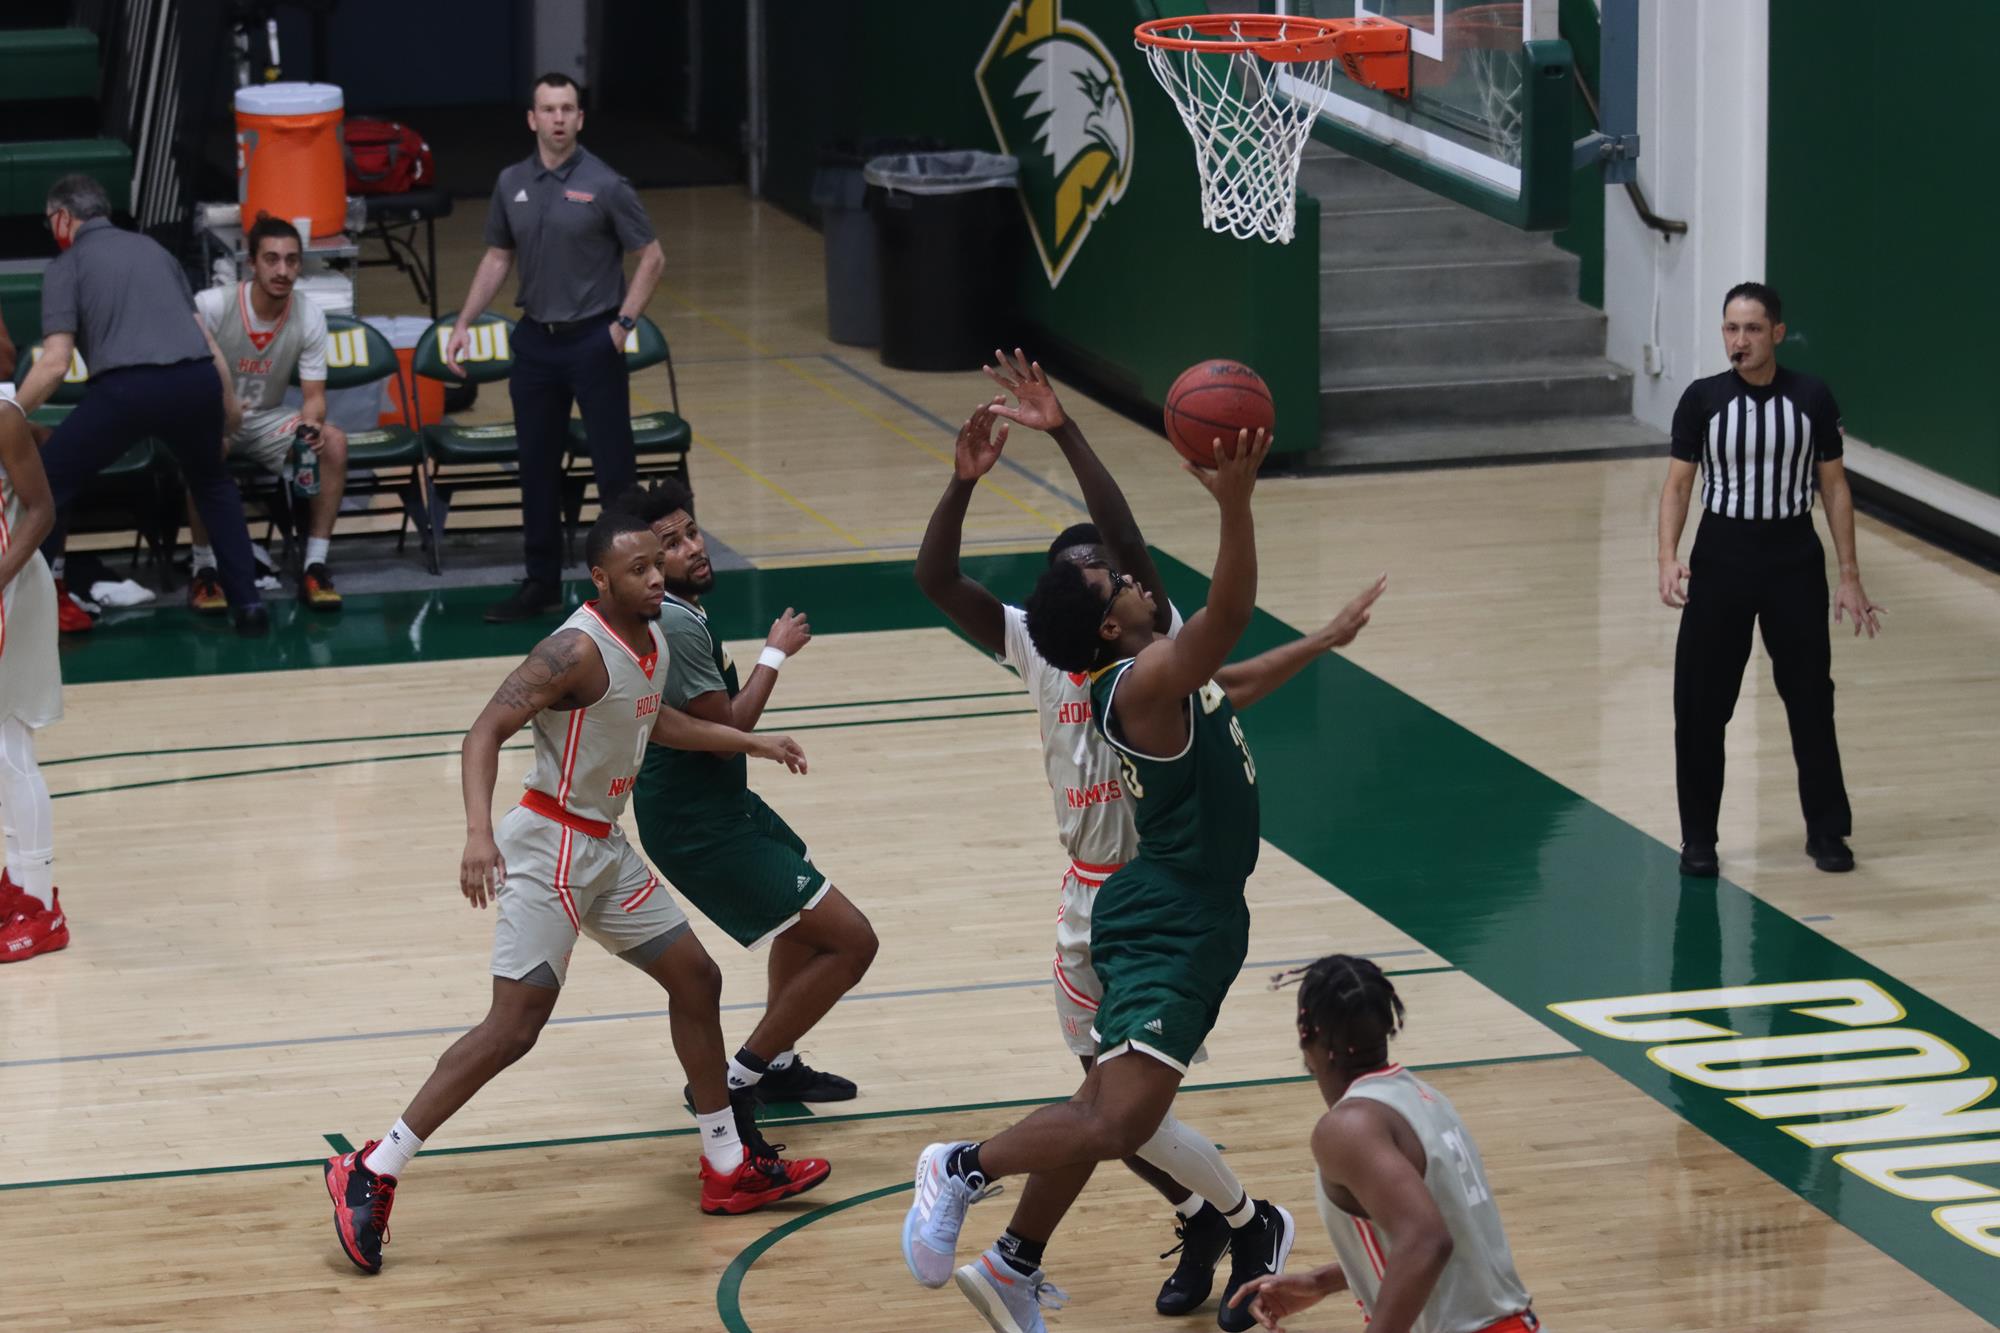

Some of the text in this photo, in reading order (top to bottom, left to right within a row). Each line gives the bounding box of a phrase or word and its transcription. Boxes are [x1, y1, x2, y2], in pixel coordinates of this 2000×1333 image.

[327, 327, 369, 368] UI
[239, 358, 272, 375] HOLY
[635, 692, 661, 720] HOLY
[1058, 701, 1093, 725] HOL
[633, 723, 649, 768] 0
[607, 775, 636, 798] NAM
